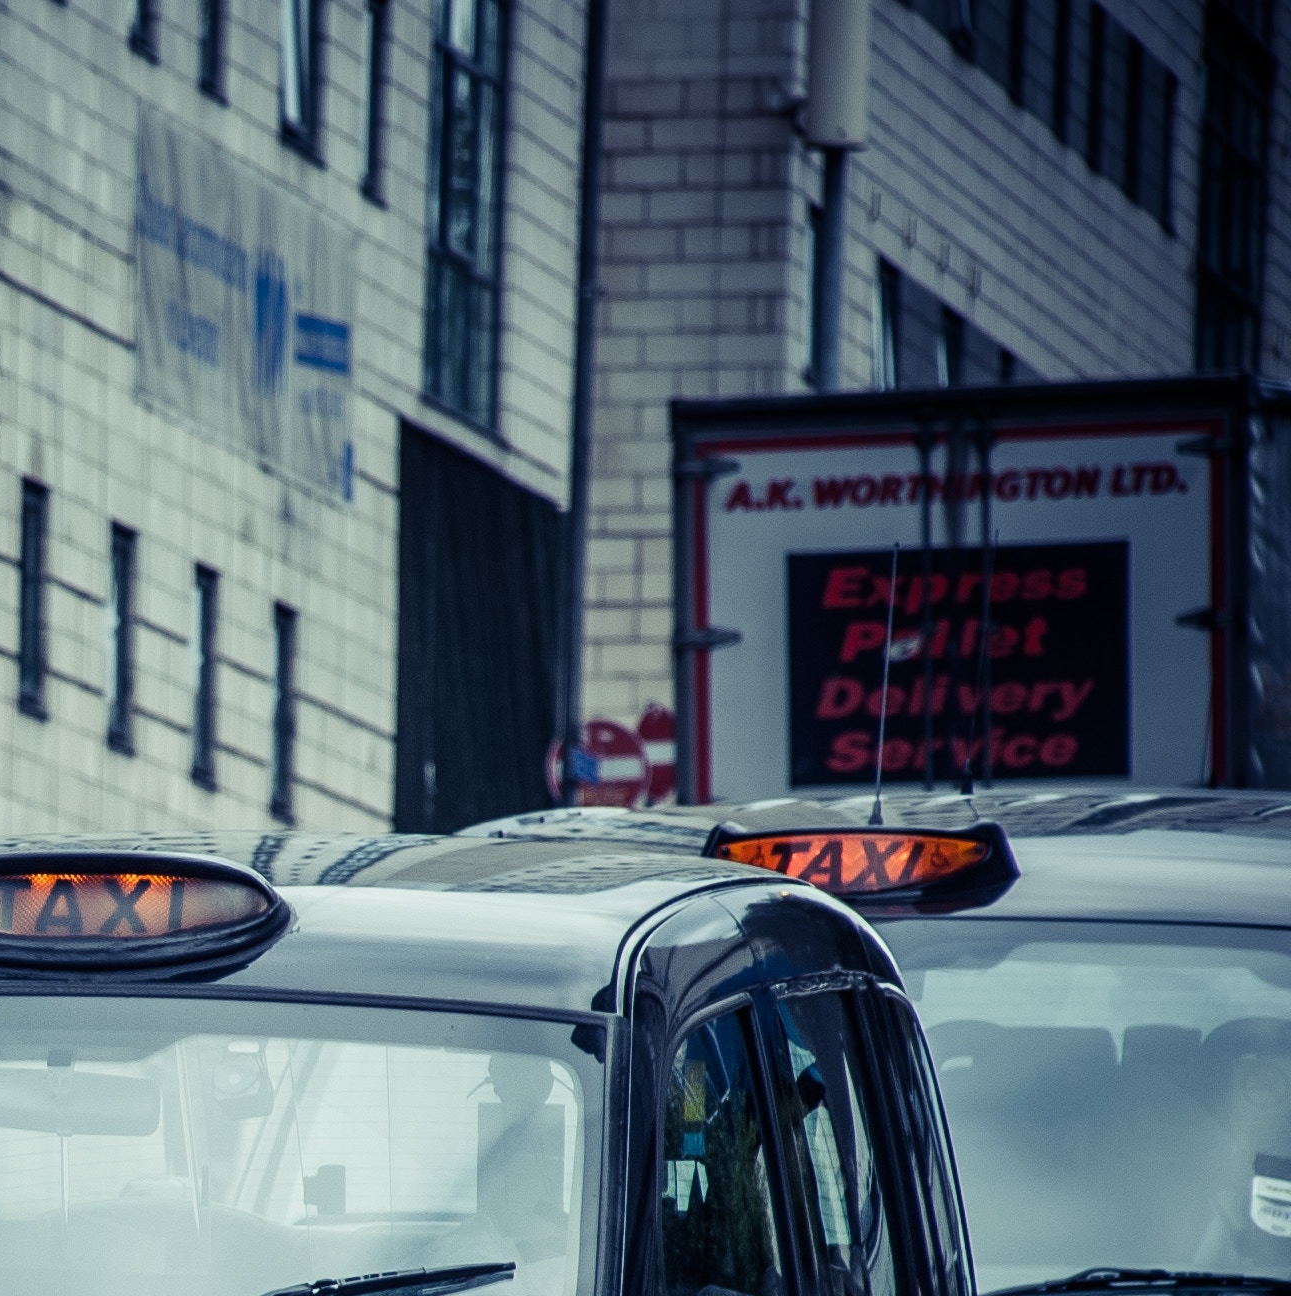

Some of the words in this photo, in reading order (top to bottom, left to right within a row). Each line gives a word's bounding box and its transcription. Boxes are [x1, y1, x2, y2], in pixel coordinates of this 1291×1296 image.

[725, 477, 804, 513] A.K.
[813, 468, 1102, 510] WORTHINGTON
[1112, 463, 1189, 497] LTD.
[821, 566, 1089, 616] Express
[815, 673, 1096, 723] Delivery
[824, 727, 1080, 773] Service
[771, 838, 925, 893] TAXI
